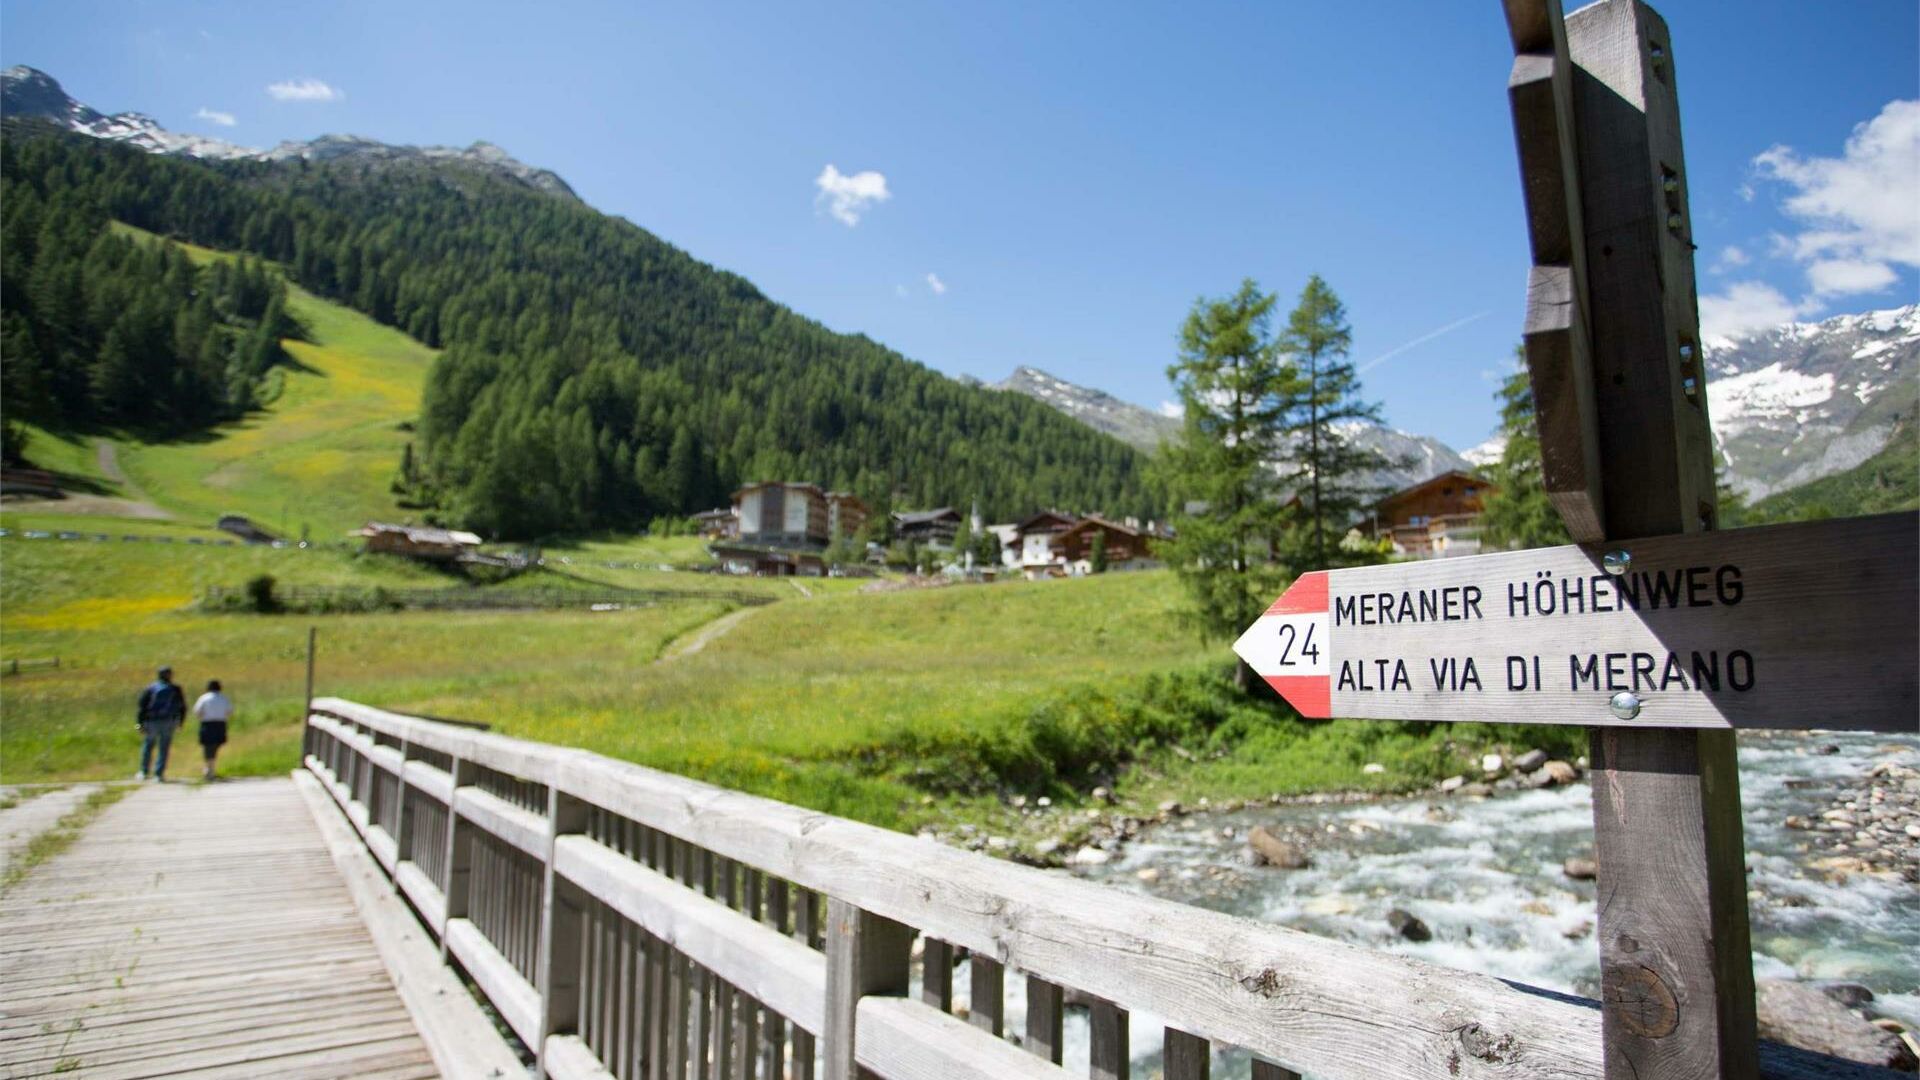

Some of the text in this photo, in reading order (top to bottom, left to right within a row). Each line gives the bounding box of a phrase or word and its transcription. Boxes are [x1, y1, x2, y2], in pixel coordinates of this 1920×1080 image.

[1335, 564, 1744, 627] MERANER HÖHENWEG
[1278, 623, 1320, 666] 24
[1338, 649, 1756, 693] ALTA VIA DI MERANO
